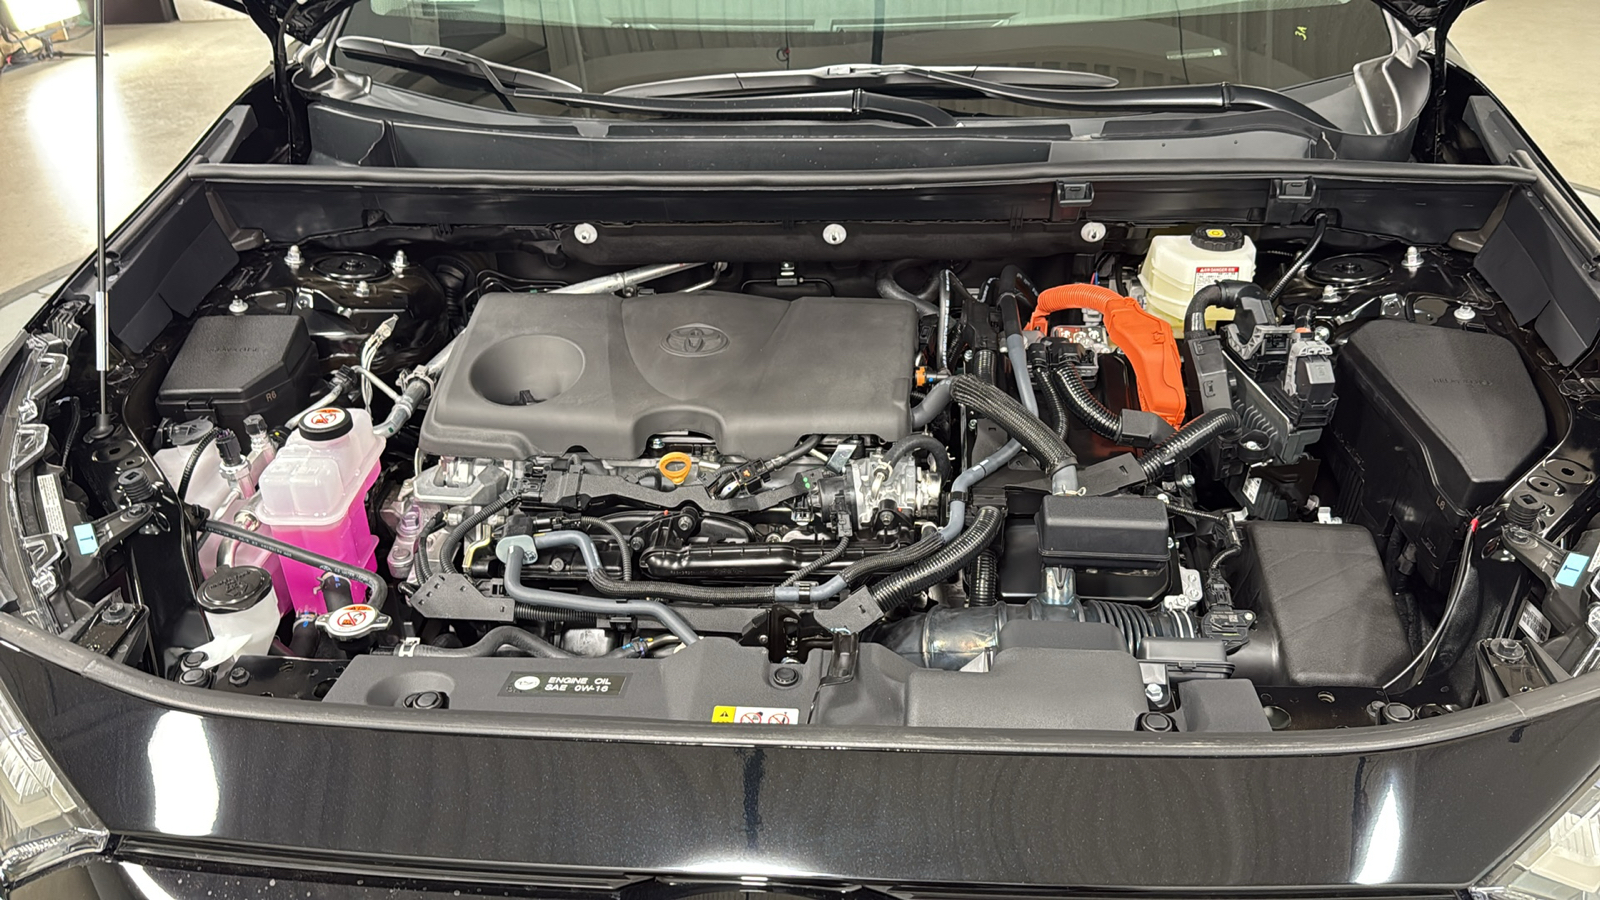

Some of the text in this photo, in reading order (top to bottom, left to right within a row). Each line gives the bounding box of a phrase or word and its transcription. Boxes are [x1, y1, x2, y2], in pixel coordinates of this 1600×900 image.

[548, 676, 611, 685] ENGINE OIL
[545, 683, 609, 693] SAE 0W-16
